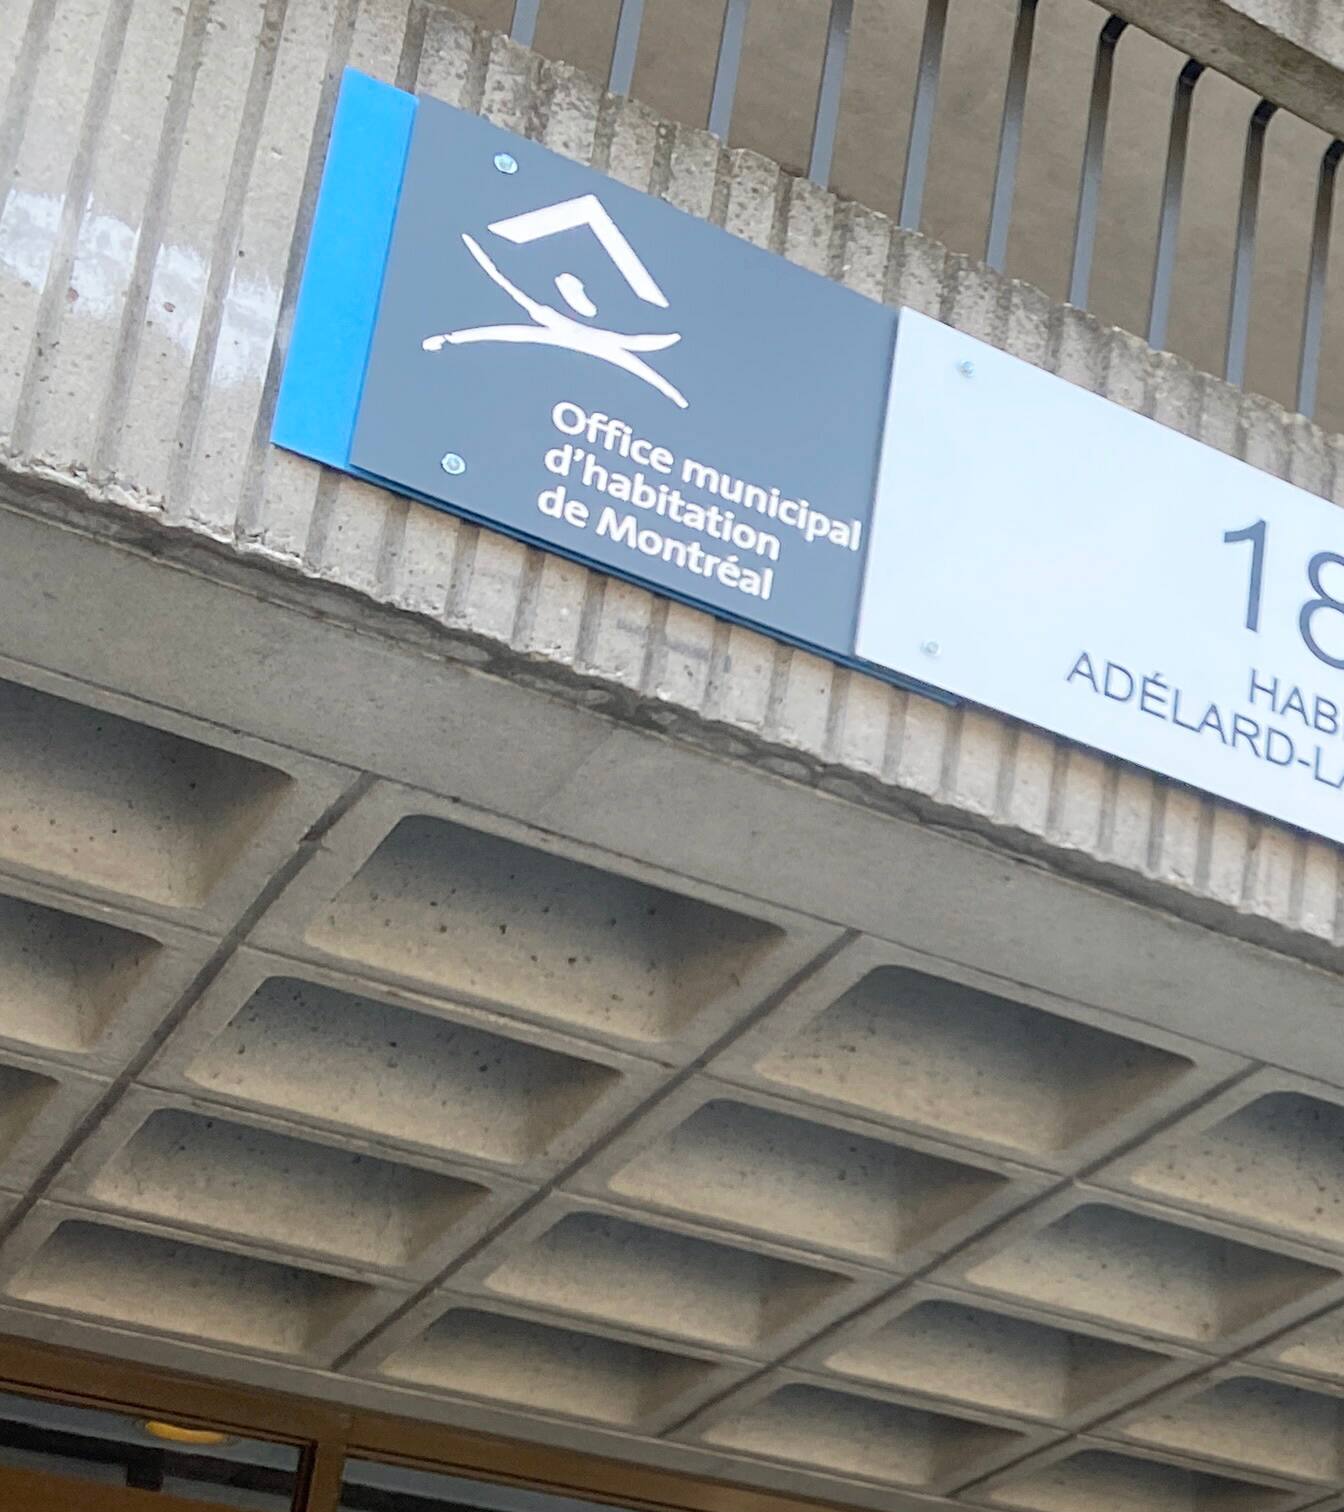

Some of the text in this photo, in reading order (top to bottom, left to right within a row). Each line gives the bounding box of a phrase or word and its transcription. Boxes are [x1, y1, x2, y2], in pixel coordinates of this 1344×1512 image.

[551, 400, 862, 551] Office municipal
[537, 486, 774, 600] de Montréal
